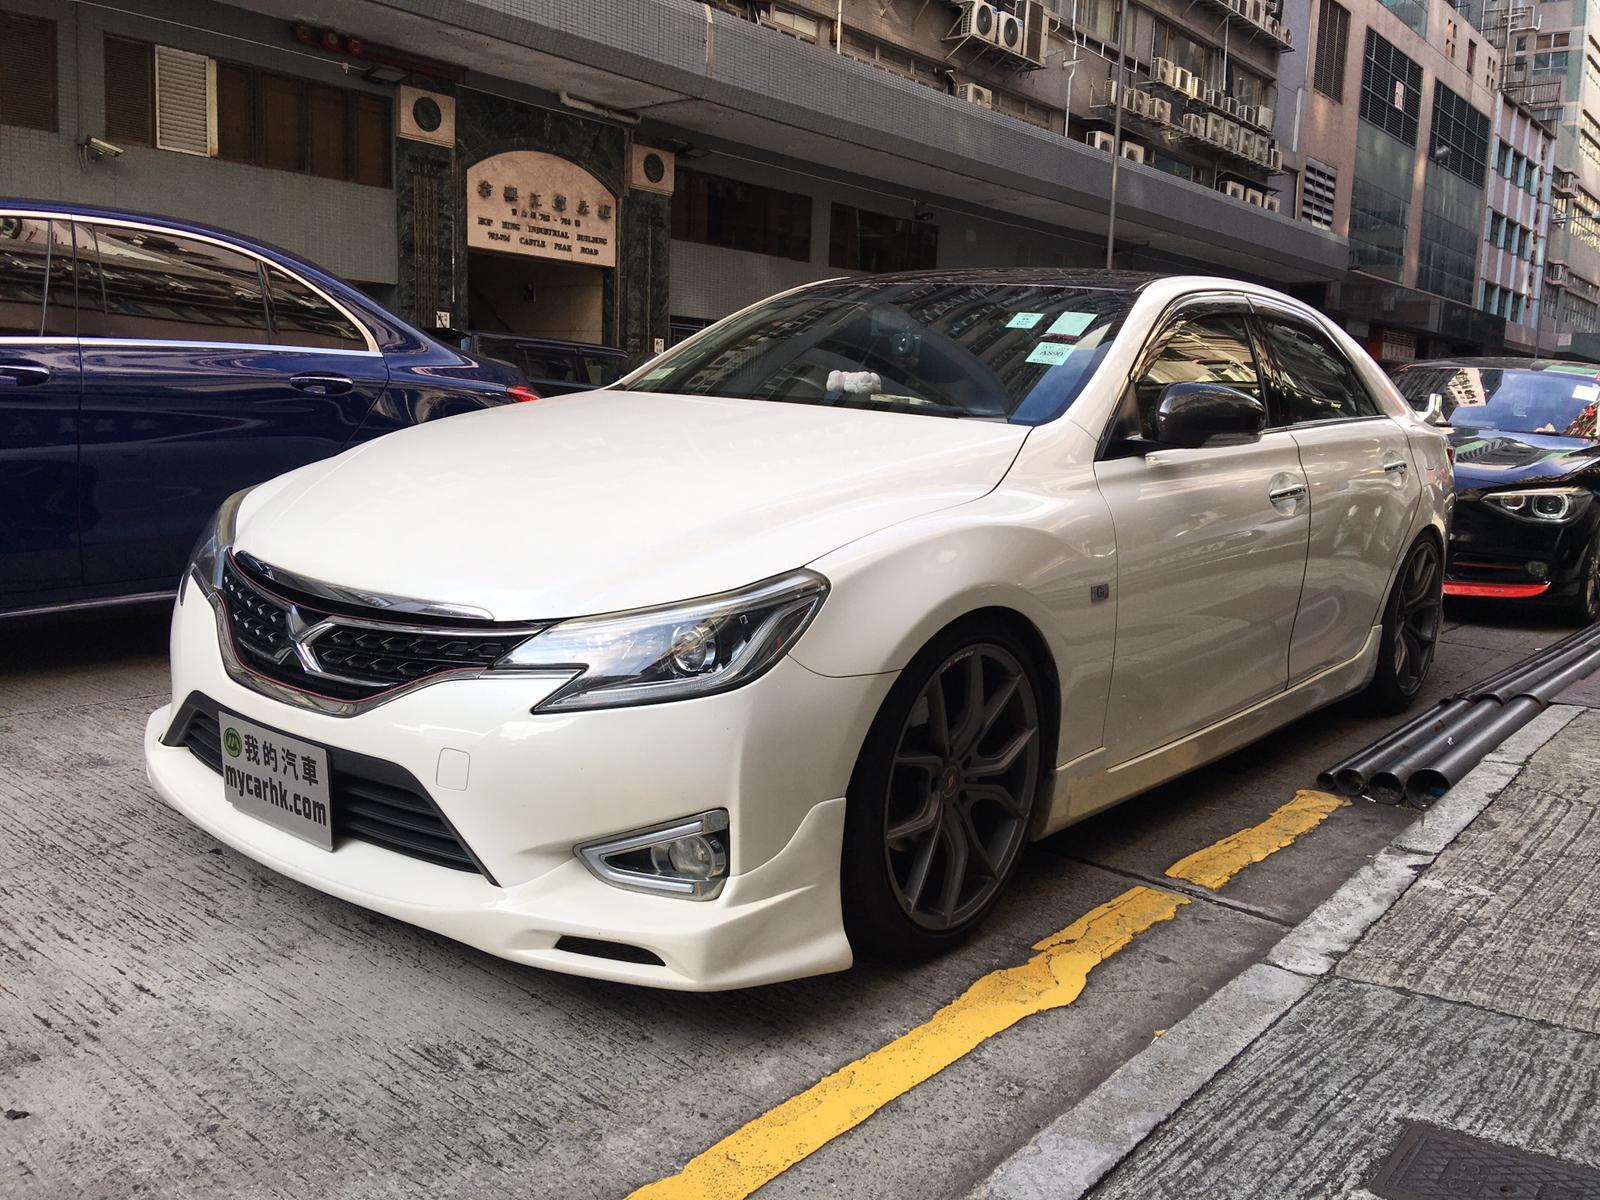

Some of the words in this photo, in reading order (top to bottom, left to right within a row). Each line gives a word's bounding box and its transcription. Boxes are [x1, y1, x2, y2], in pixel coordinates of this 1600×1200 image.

[519, 237, 546, 248] CASTLE
[554, 243, 572, 252] PEAK
[580, 246, 599, 256] ROAD
[528, 225, 570, 239] INDUSTRIAL
[576, 234, 608, 245] BUILDING
[244, 734, 319, 786] 我的汽車
[225, 764, 327, 826] mycarhk.com
